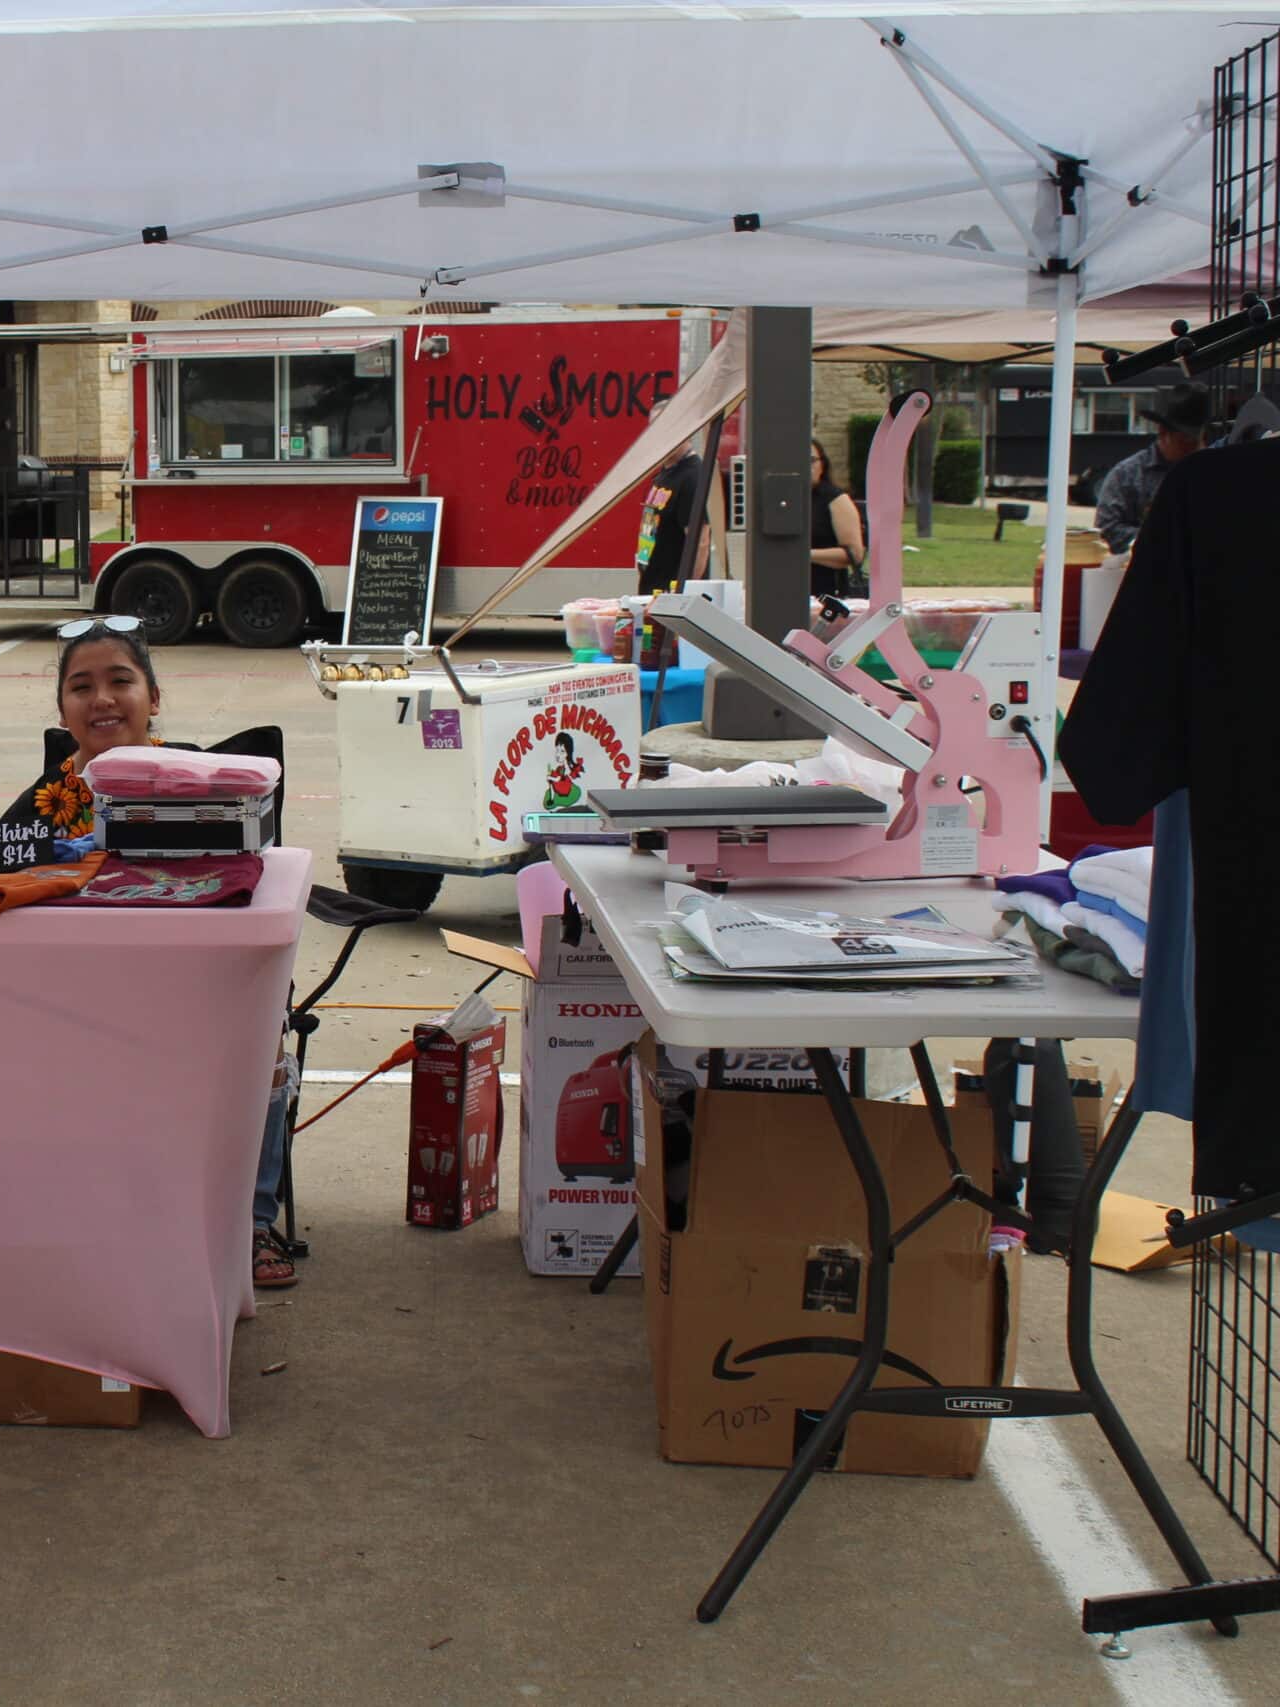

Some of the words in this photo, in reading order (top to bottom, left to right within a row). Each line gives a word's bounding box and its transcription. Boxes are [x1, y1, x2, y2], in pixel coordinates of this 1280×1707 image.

[426, 373, 522, 420] HOLY
[533, 355, 675, 426] SMOKE
[516, 446, 583, 479] BBQ
[524, 484, 590, 508] more
[391, 510, 425, 525] pepsi
[376, 533, 414, 547] MENU
[397, 696, 410, 724] 7
[533, 706, 557, 741] DE
[431, 737, 455, 748] 2012
[560, 704, 633, 790] MICHOACA
[493, 726, 534, 796] FLOR
[489, 801, 508, 842] LA
[2, 843, 36, 866] $14
[558, 1003, 644, 1018] HOND
[559, 1037, 595, 1048] Bluetooth
[570, 1088, 599, 1099] HONDA
[549, 1189, 600, 1205] POWER
[602, 1190, 629, 1205] YOU
[414, 1203, 432, 1217] 14
[953, 1400, 1005, 1409] LIFETIME
